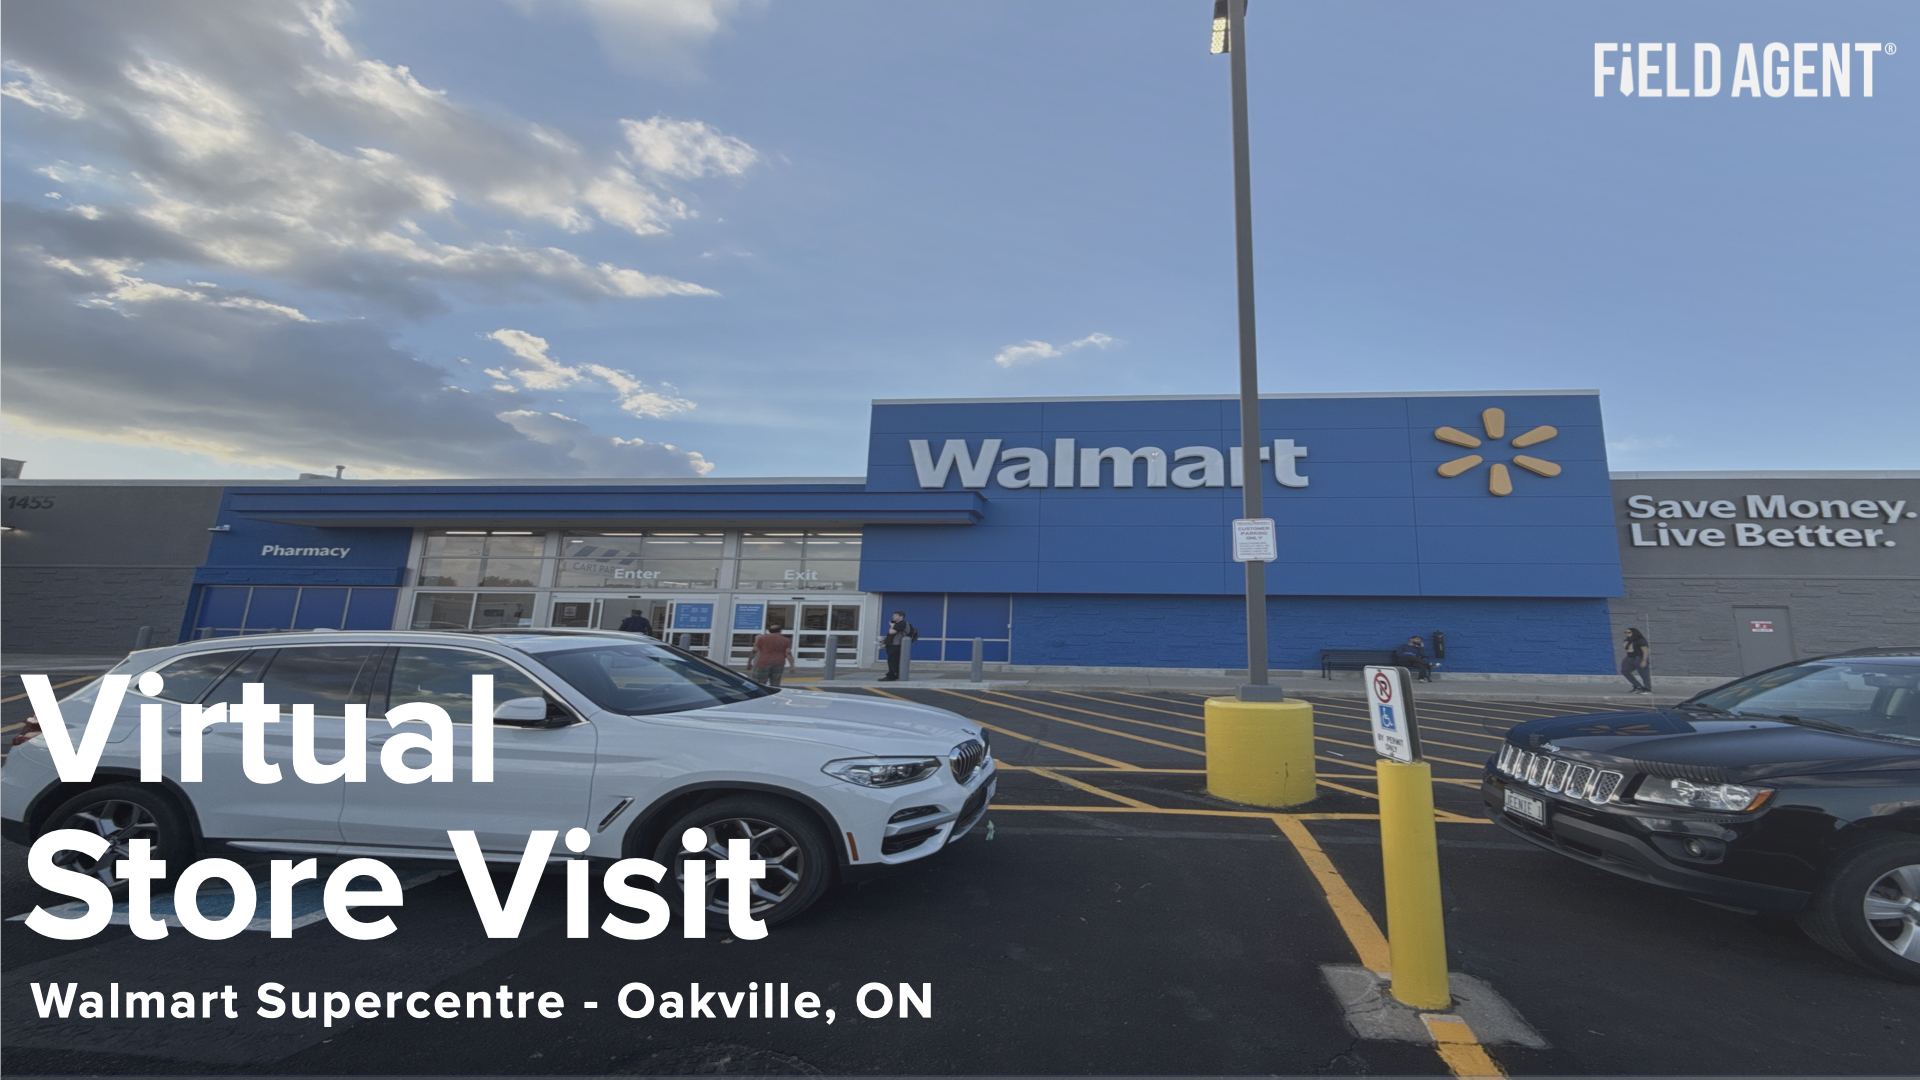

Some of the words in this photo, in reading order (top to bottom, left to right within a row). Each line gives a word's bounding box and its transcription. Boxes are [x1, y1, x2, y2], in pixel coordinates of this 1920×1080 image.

[908, 437, 1310, 489] Walmart
[8, 495, 56, 510] 1455
[1627, 494, 1737, 520] Save
[1744, 494, 1918, 524] Money.
[1629, 521, 1726, 548] Live
[1733, 522, 1897, 548] Better.
[261, 544, 351, 559] Pharmacy
[573, 562, 598, 573] CART
[599, 565, 622, 575] PAR
[614, 568, 661, 579] Enter
[784, 568, 818, 582] Exit
[1377, 733, 1384, 741] BY
[1386, 735, 1404, 747] PERMIT
[1386, 743, 1398, 753] ONLY
[1505, 795, 1532, 815] JEENIE
